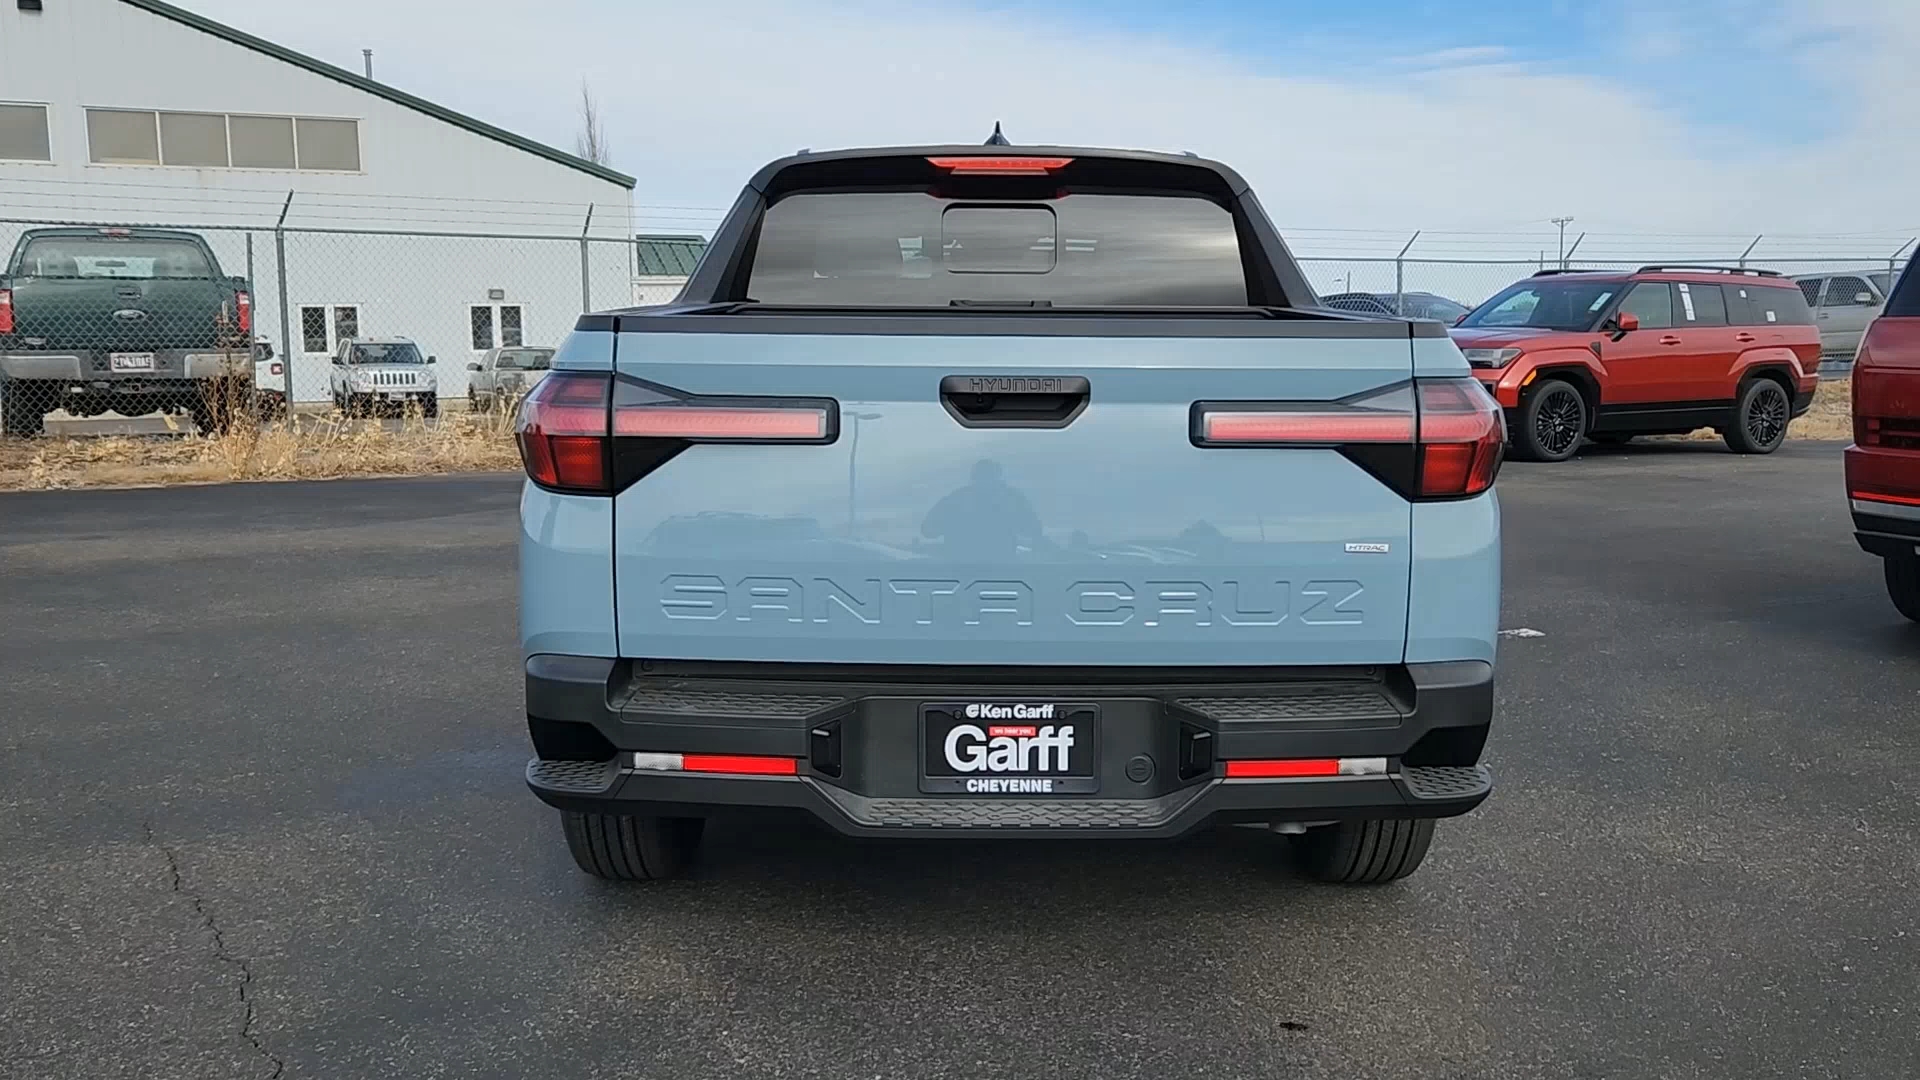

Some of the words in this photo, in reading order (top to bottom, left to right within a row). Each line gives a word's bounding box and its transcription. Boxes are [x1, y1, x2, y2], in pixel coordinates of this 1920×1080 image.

[969, 378, 1062, 393] HYUNDAI
[1348, 544, 1386, 552] HTRAC
[659, 574, 1033, 626] SANTA
[1065, 580, 1364, 626] CRUZ
[980, 703, 1012, 719] Ken
[1013, 703, 1054, 719] Garff
[944, 724, 1074, 773] Garff
[966, 779, 1053, 793] CHEYENNE
